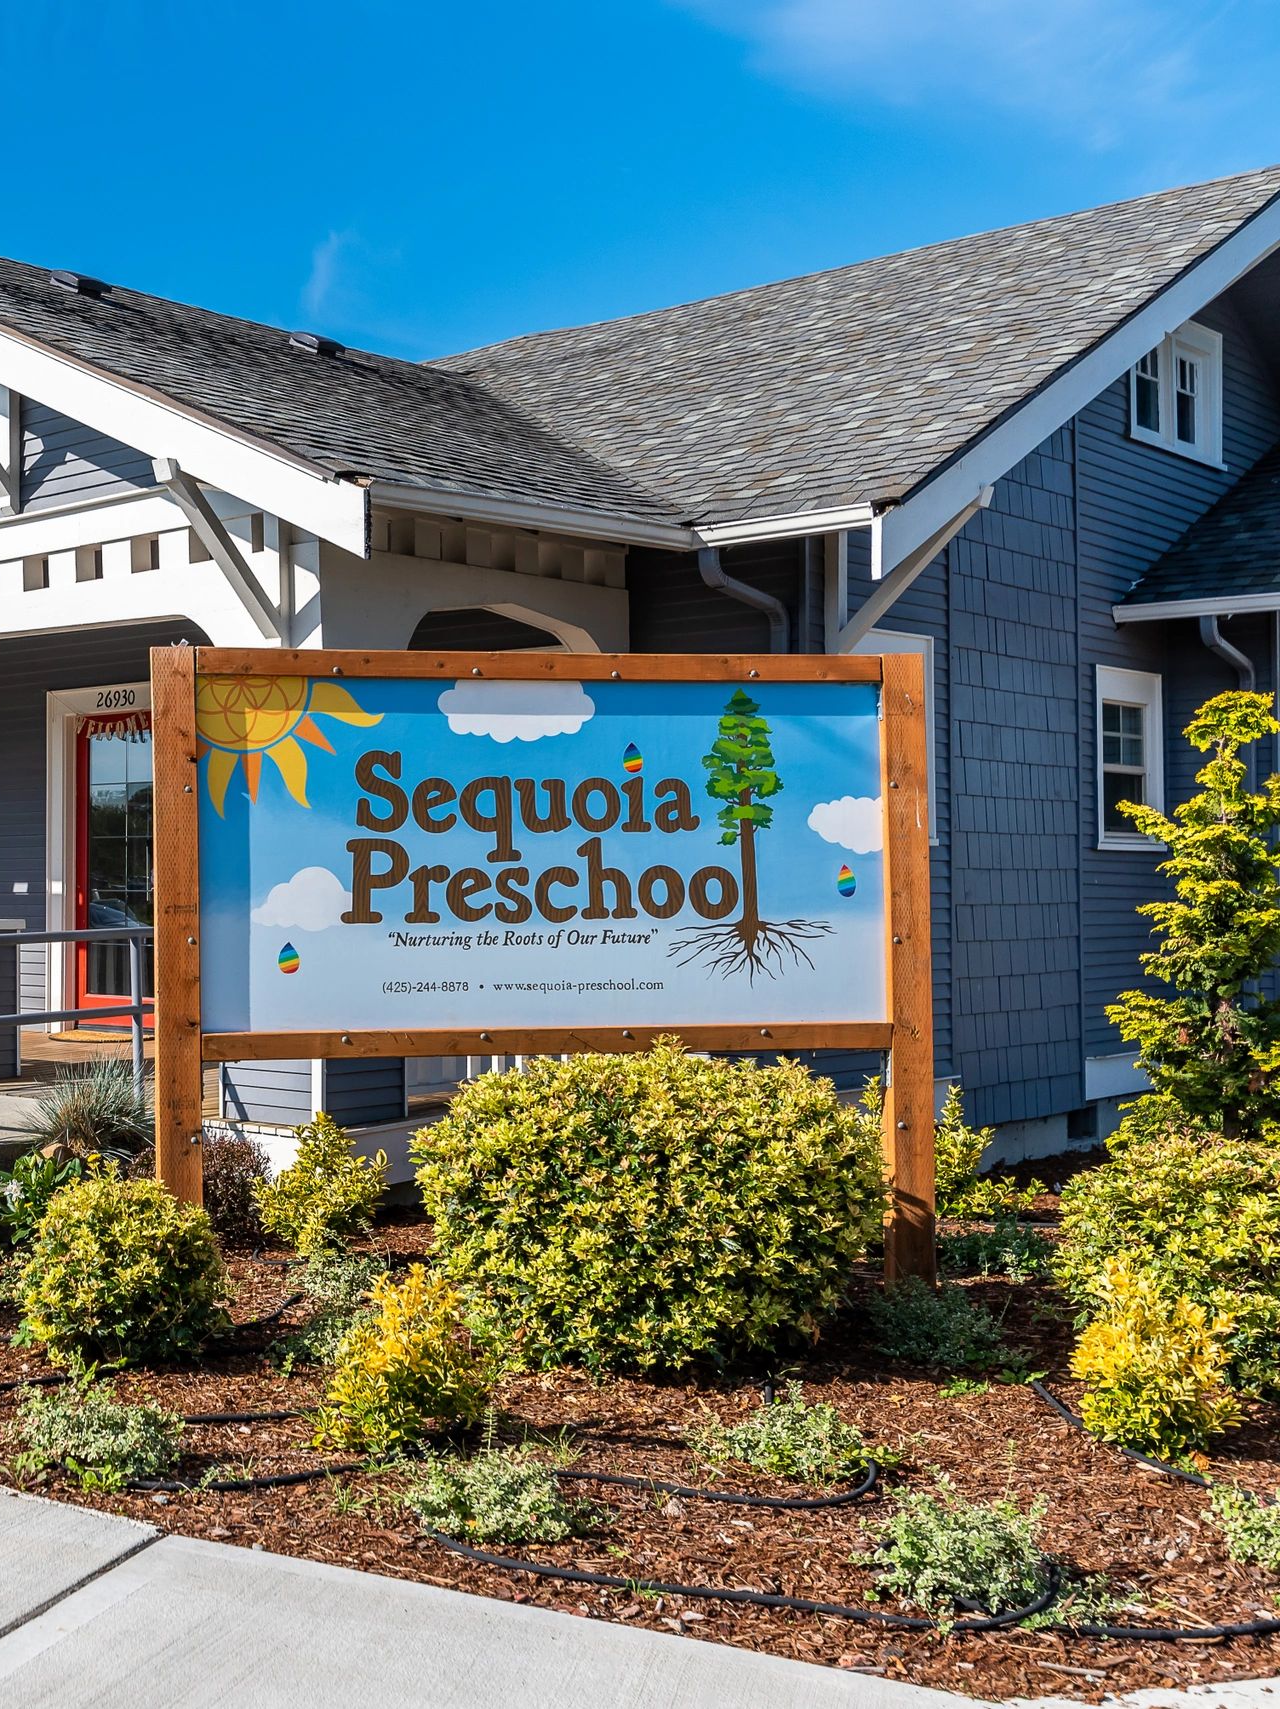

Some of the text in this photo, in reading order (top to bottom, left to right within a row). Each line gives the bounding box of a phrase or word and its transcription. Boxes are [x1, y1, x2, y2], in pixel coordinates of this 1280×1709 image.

[96, 689, 136, 708] 26930
[74, 710, 149, 741] WELCOME
[355, 743, 700, 862] Sequoia
[340, 837, 757, 923] Preschool
[388, 929, 659, 950] “Nurturing the Roots of Our Future”
[382, 979, 664, 994] (425)-244-8878 www.sequoia-preschool.com
